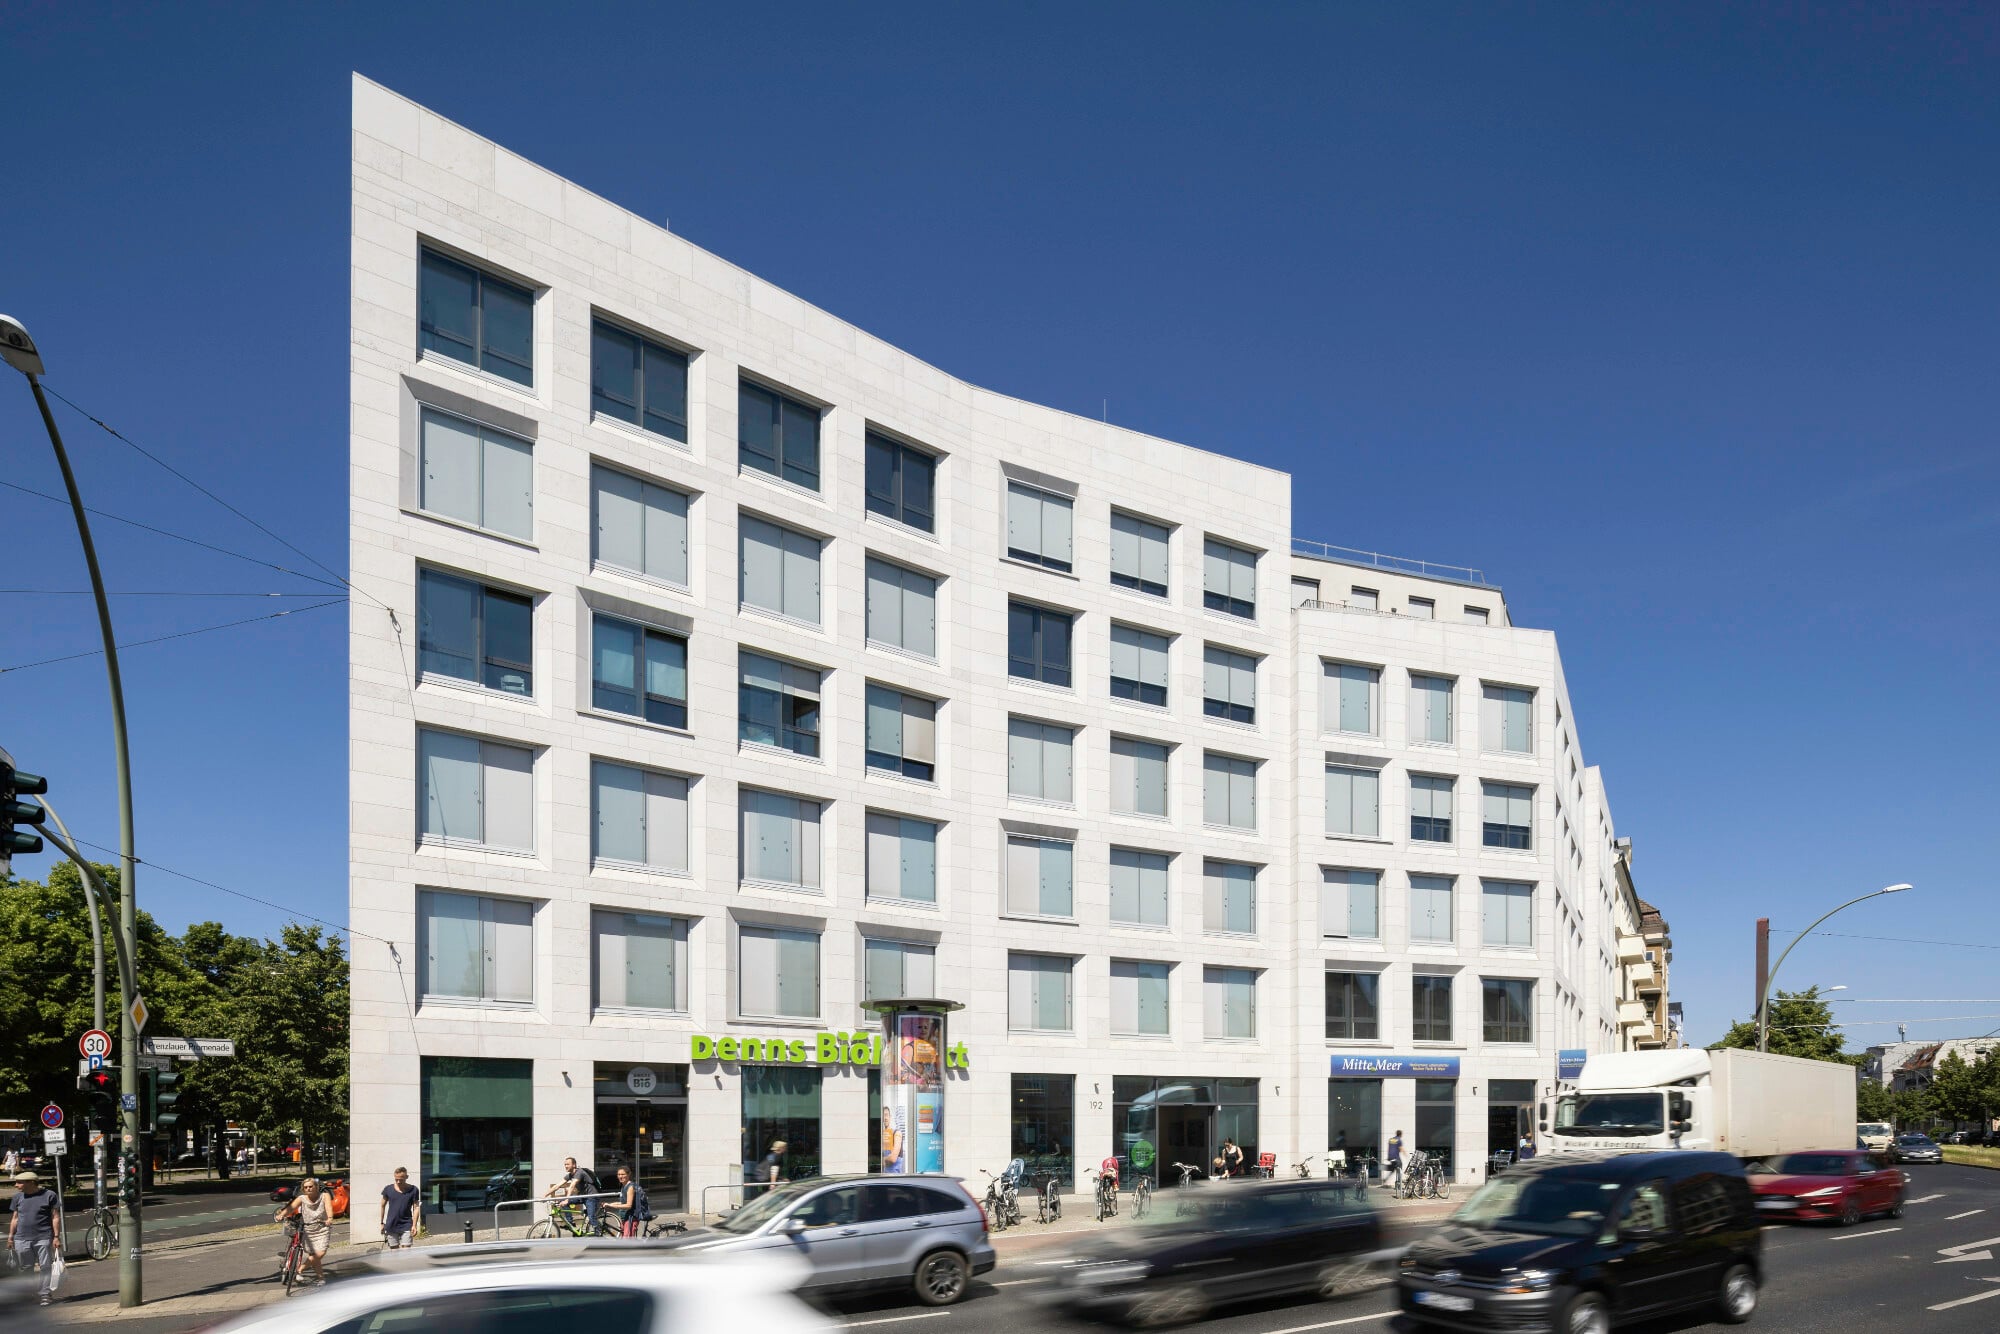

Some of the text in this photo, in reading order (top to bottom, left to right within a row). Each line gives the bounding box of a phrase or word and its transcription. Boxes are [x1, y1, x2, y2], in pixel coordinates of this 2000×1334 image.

[87, 1038, 105, 1052] 30
[148, 1041, 230, 1052] Prenzlauer Promenade
[691, 1034, 807, 1063] Denns
[1342, 1058, 1403, 1071] Mitte Meer
[1090, 1101, 1103, 1110] 192
